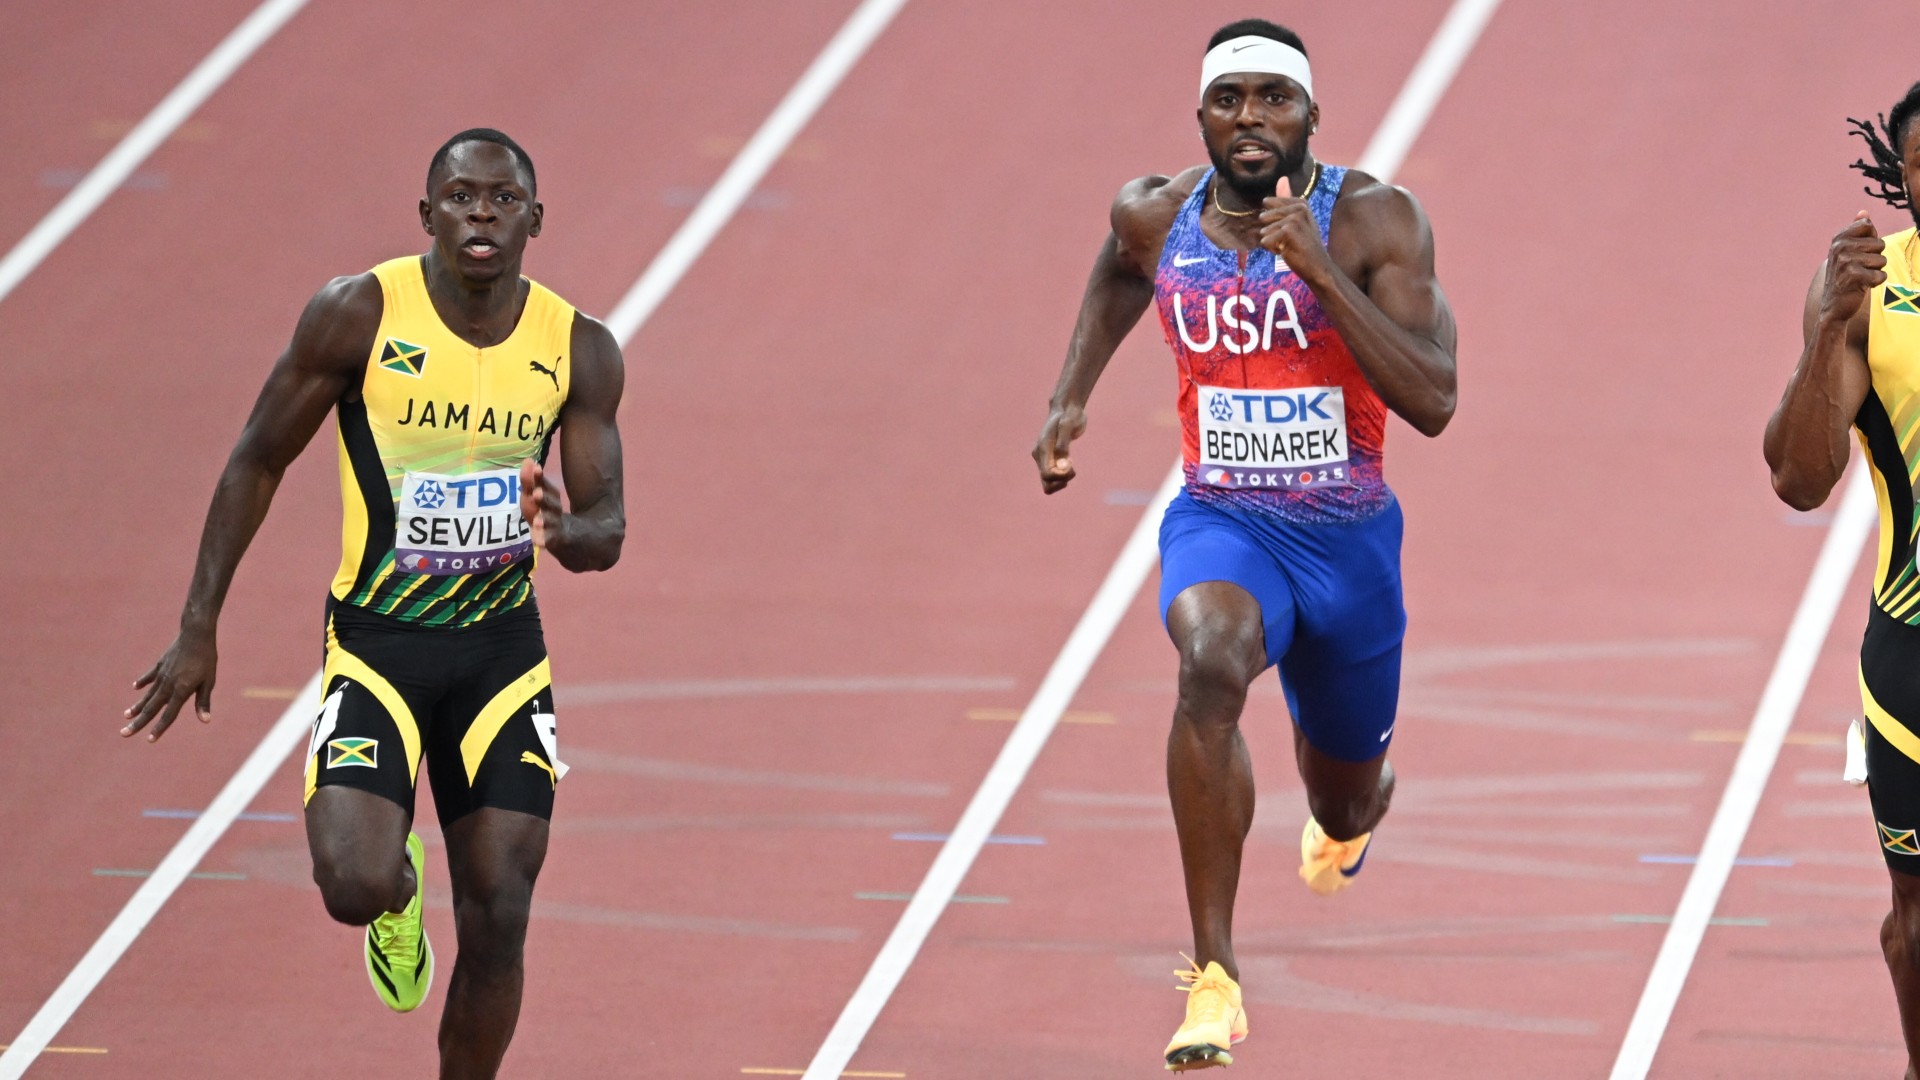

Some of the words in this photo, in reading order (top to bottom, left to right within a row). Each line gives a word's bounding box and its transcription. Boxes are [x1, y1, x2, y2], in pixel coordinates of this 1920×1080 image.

[1173, 289, 1308, 354] USA
[397, 398, 544, 441] JAMAICA
[1232, 392, 1332, 424] TDK
[1207, 428, 1340, 463] BEDNAREK
